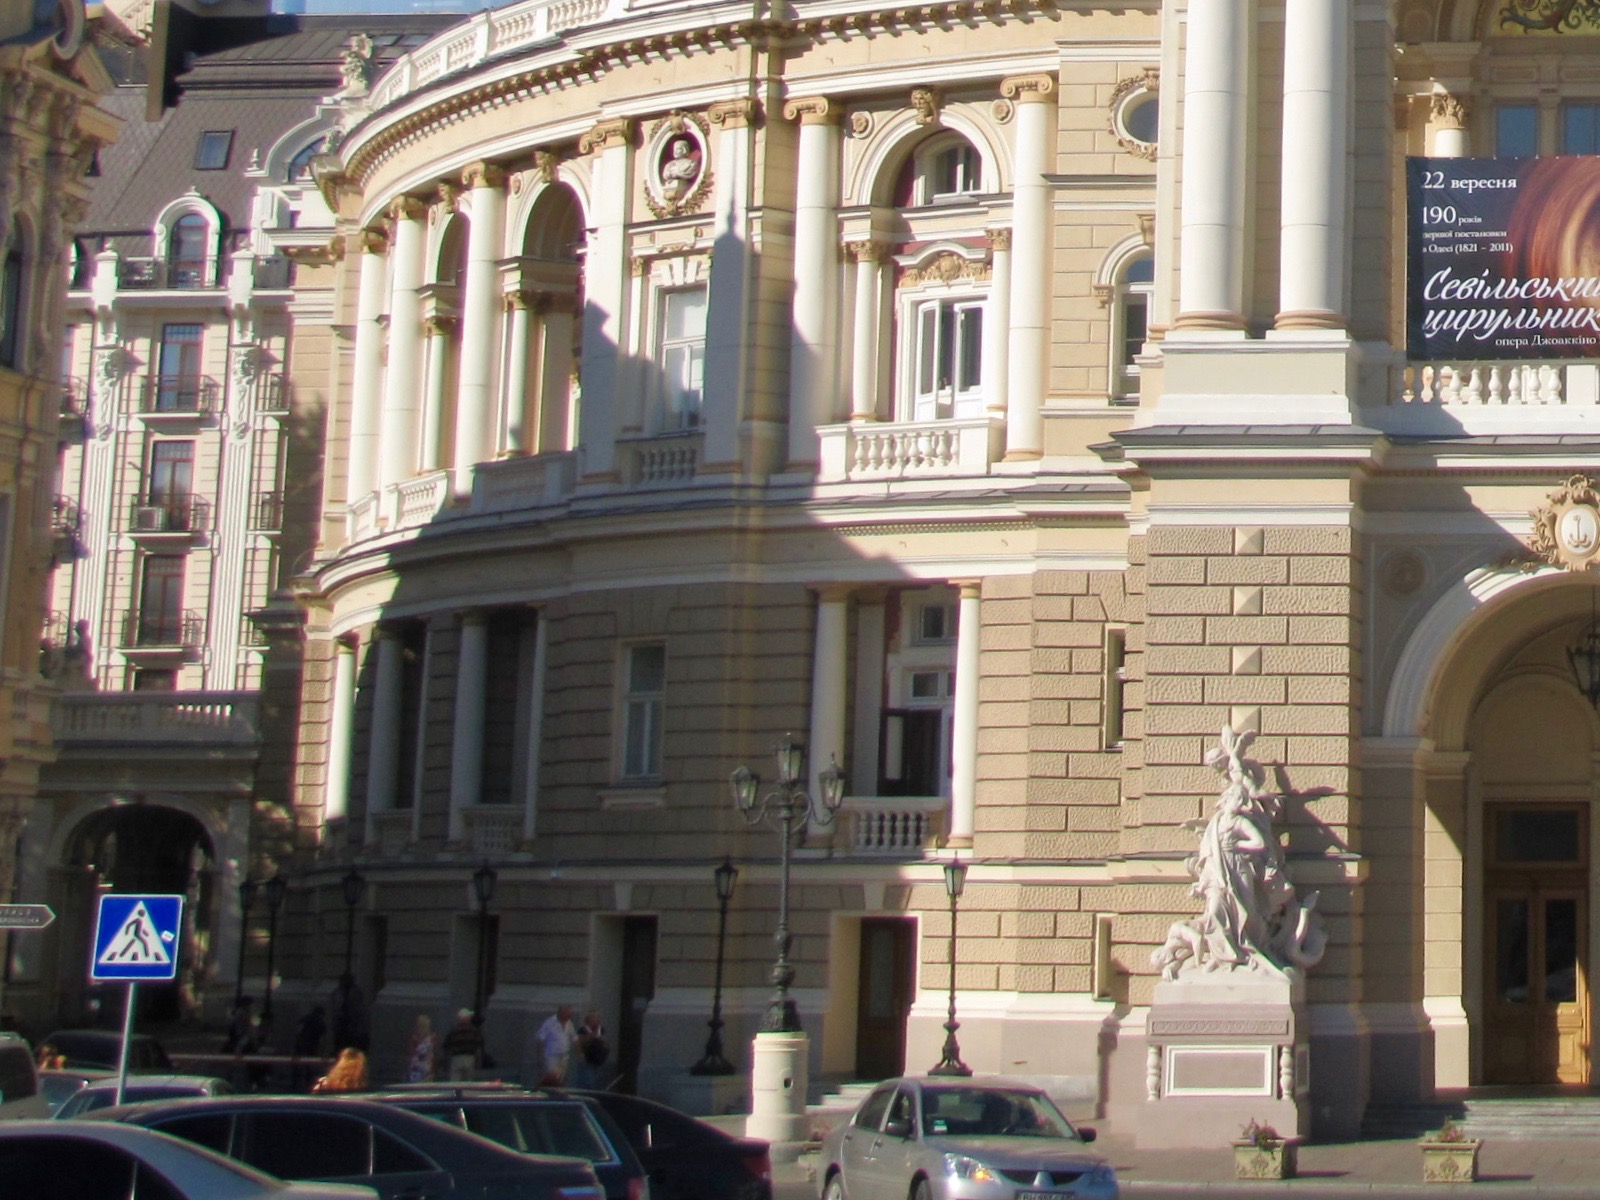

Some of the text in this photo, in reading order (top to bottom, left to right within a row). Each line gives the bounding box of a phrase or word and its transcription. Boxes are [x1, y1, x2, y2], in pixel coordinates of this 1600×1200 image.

[1421, 171, 1517, 193] 22 вересня
[1422, 205, 1482, 226] 190 років
[1454, 230, 1507, 238] постановки
[1428, 243, 1453, 253] Одесі
[1495, 337, 1529, 349] опера
[1531, 334, 1597, 346] Джоаккіно
